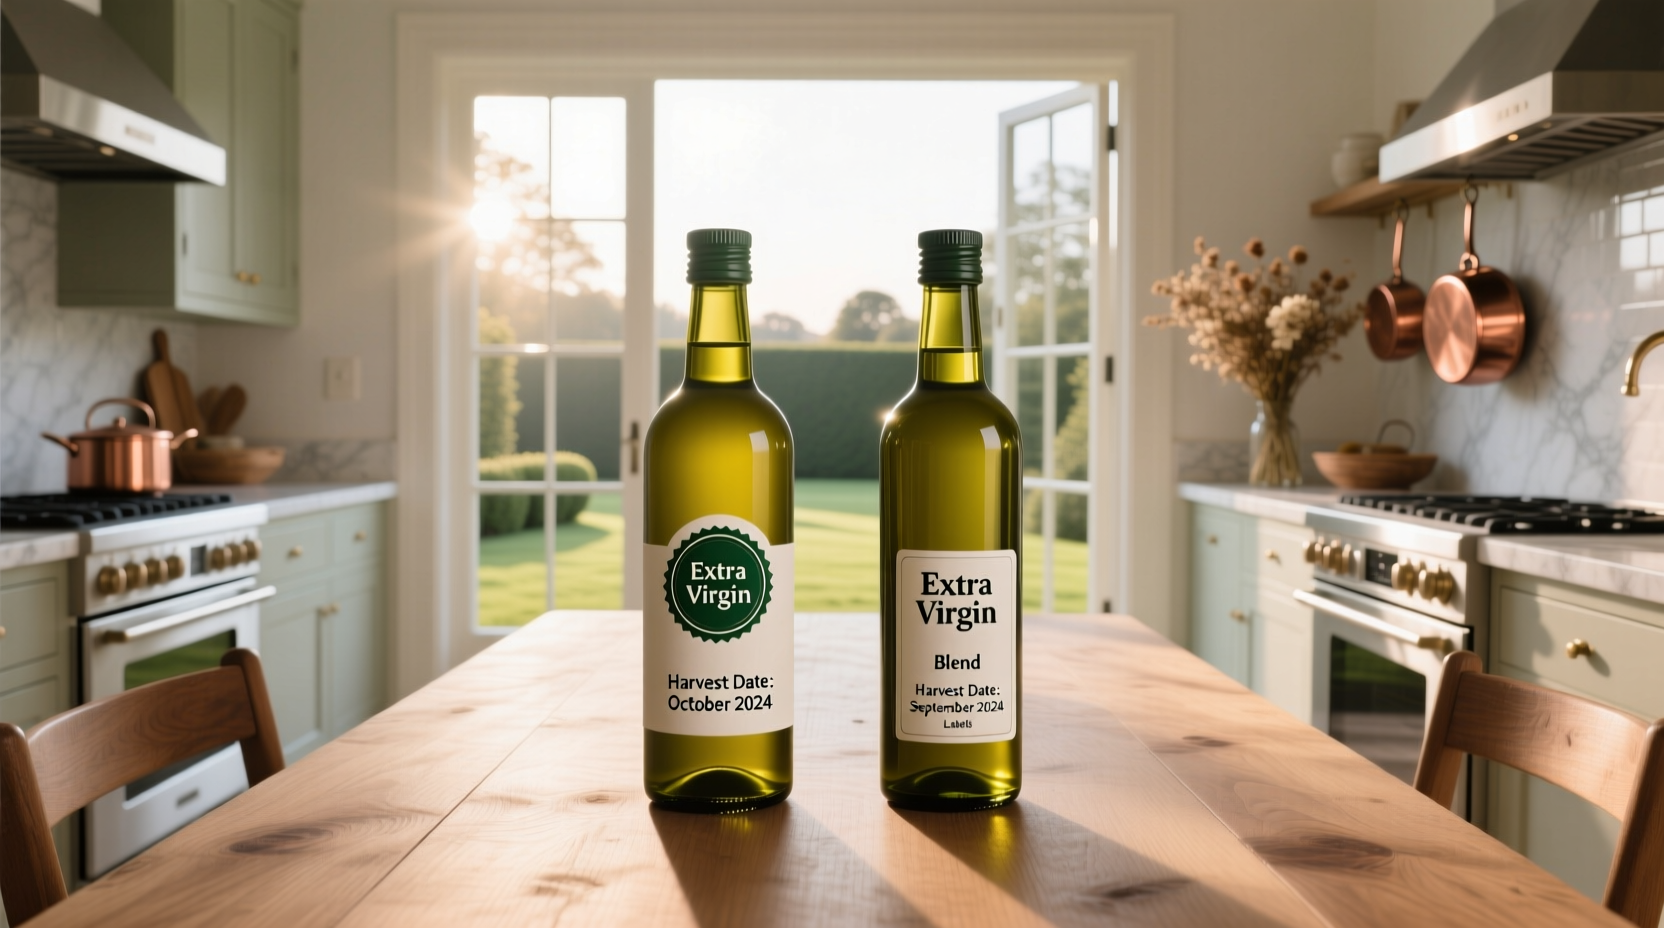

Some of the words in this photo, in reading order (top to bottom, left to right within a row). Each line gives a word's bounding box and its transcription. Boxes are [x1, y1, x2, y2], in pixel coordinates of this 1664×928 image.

[690, 561, 747, 581] Extra
[920, 571, 993, 596] Extra
[686, 584, 751, 611] Virgin
[915, 600, 997, 632] Virgin
[934, 653, 981, 670] Blend
[668, 673, 730, 690] Harvest
[733, 674, 774, 690] Date:
[915, 683, 965, 697] Harvest
[968, 684, 1001, 697] Date:
[668, 694, 731, 712] October
[735, 694, 773, 712] 2024
[909, 700, 975, 717] September
[976, 700, 1005, 713] 2024
